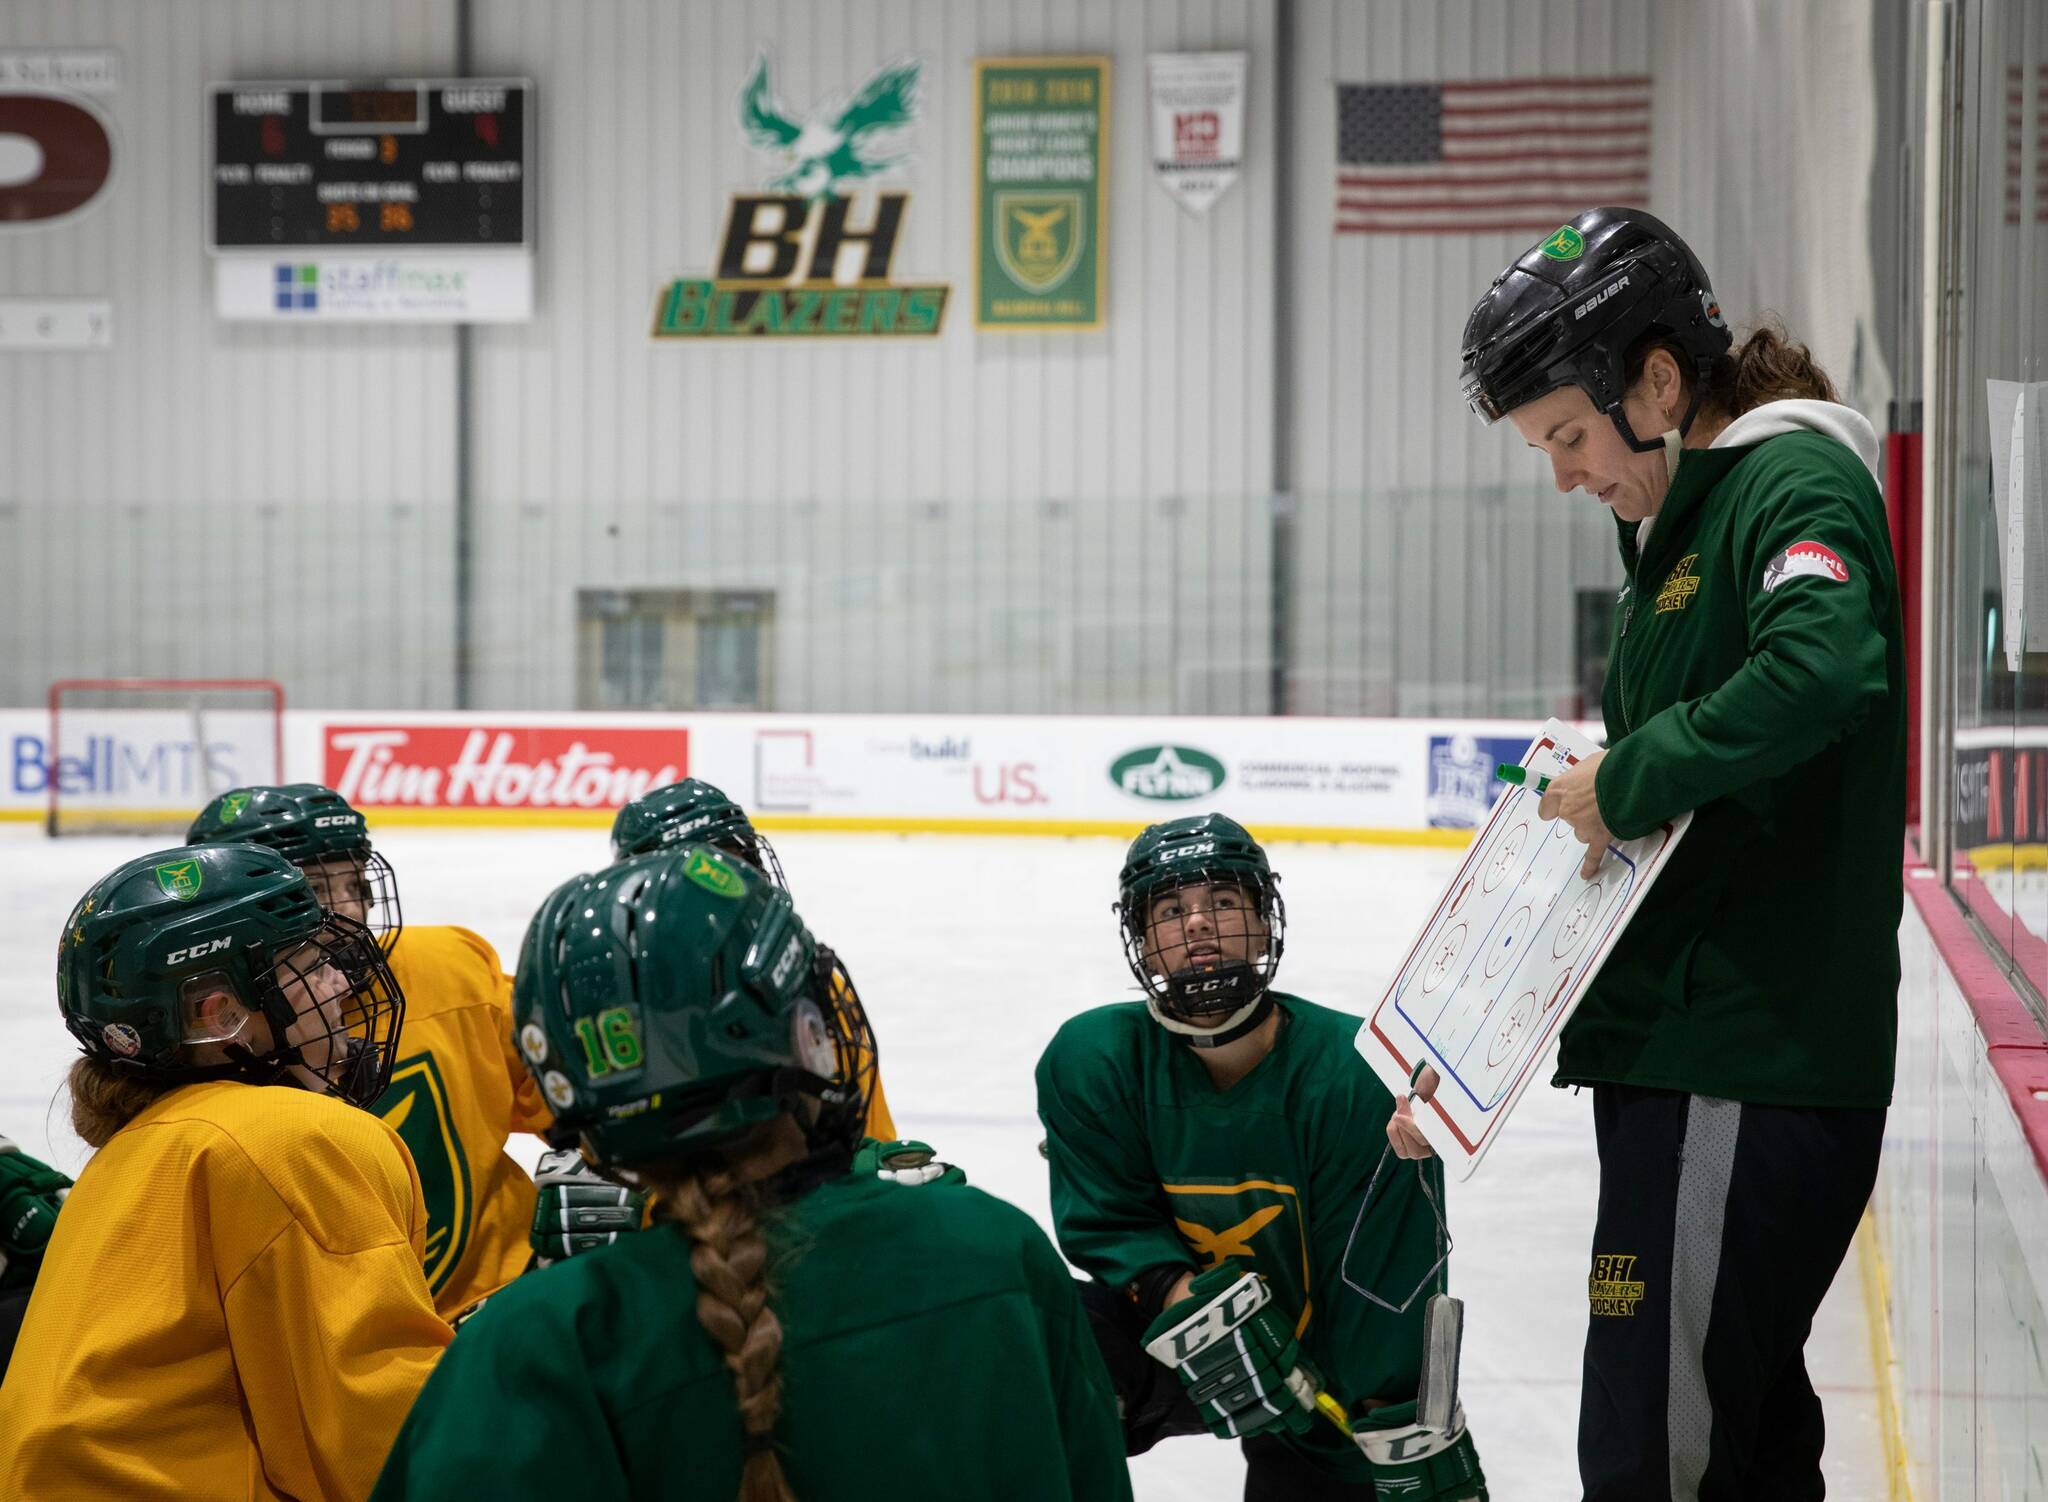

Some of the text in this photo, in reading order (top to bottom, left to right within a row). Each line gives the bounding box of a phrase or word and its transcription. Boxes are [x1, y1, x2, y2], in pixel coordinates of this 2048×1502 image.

[716, 193, 908, 281] BH
[324, 260, 466, 292] staffmax
[663, 279, 943, 334] BLAZERS
[1575, 275, 1631, 320] BAUER
[910, 737, 968, 759] build
[331, 730, 441, 806] Tim
[314, 815, 357, 829] CCM
[662, 815, 710, 843] CCM
[1159, 842, 1215, 862] CCM
[166, 936, 232, 965] CCM
[1184, 976, 1239, 995] CCM
[575, 1007, 643, 1080] 16
[1593, 1255, 1637, 1282] BH
[1169, 1279, 1262, 1360] CC
[1590, 1297, 1637, 1316] HOCKEY
